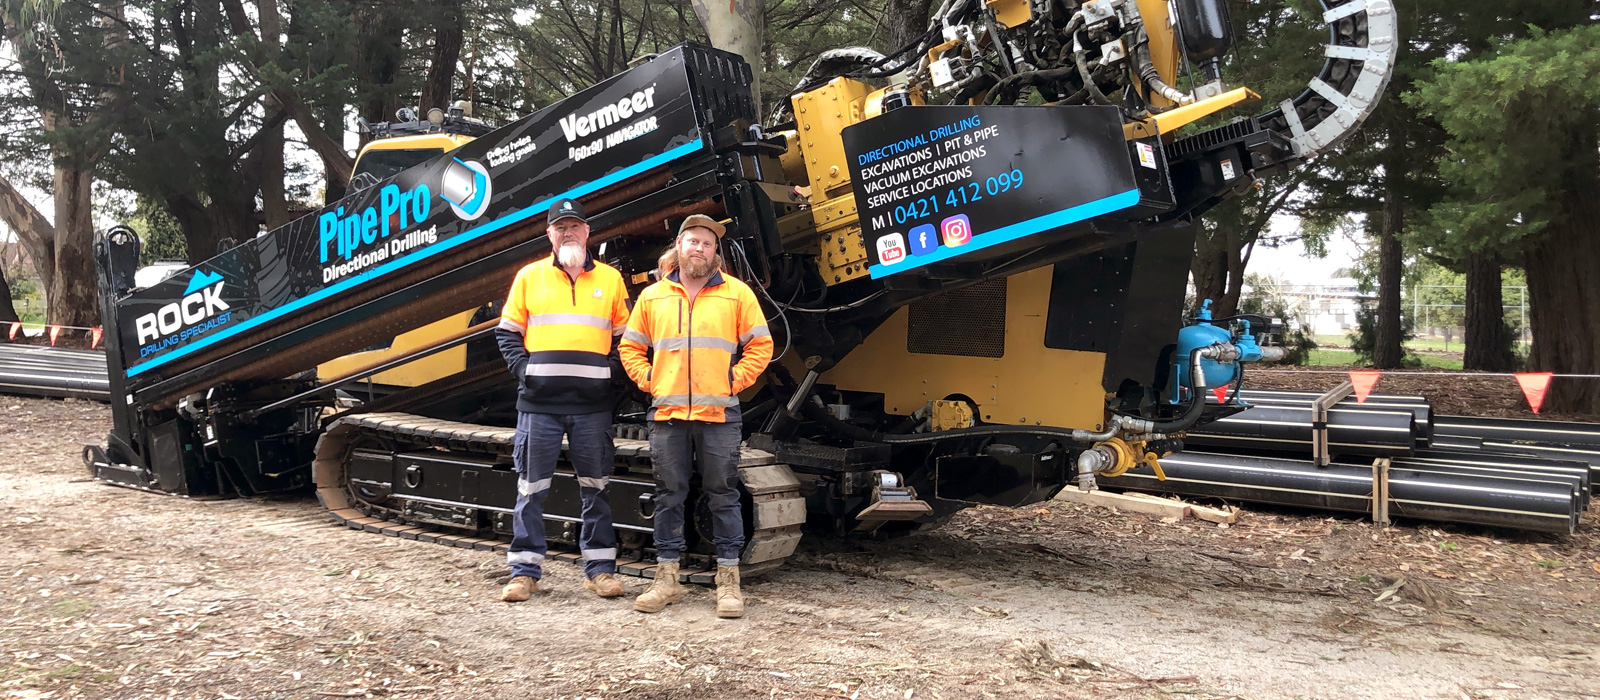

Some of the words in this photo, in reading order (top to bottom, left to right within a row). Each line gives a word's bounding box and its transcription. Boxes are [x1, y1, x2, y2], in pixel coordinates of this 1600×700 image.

[559, 86, 655, 143] Vermeer
[606, 115, 659, 149] NAVIGATOR
[510, 135, 531, 150] holes
[858, 134, 928, 166] DIRECTIONAL
[929, 114, 981, 142] DRILLING
[860, 147, 932, 180] EXCAVATIONS
[944, 137, 961, 153] PIT
[964, 134, 973, 146] &
[973, 125, 999, 143] PIPE
[863, 171, 911, 194] VACUUM
[911, 145, 987, 179] EXCAVATIONS
[867, 187, 909, 209] SERVICE
[911, 166, 973, 195] LOCATIONS
[871, 215, 885, 231] M
[894, 195, 939, 224] 0421
[945, 182, 982, 208] 412
[985, 168, 1024, 196] 099
[323, 242, 389, 283] Directional
[391, 224, 438, 256] Drilling
[883, 239, 897, 248] You
[883, 250, 900, 260] Tube
[135, 281, 231, 346] ROCK
[140, 334, 179, 358] DRILLING
[180, 311, 232, 341] SPECIALIST
